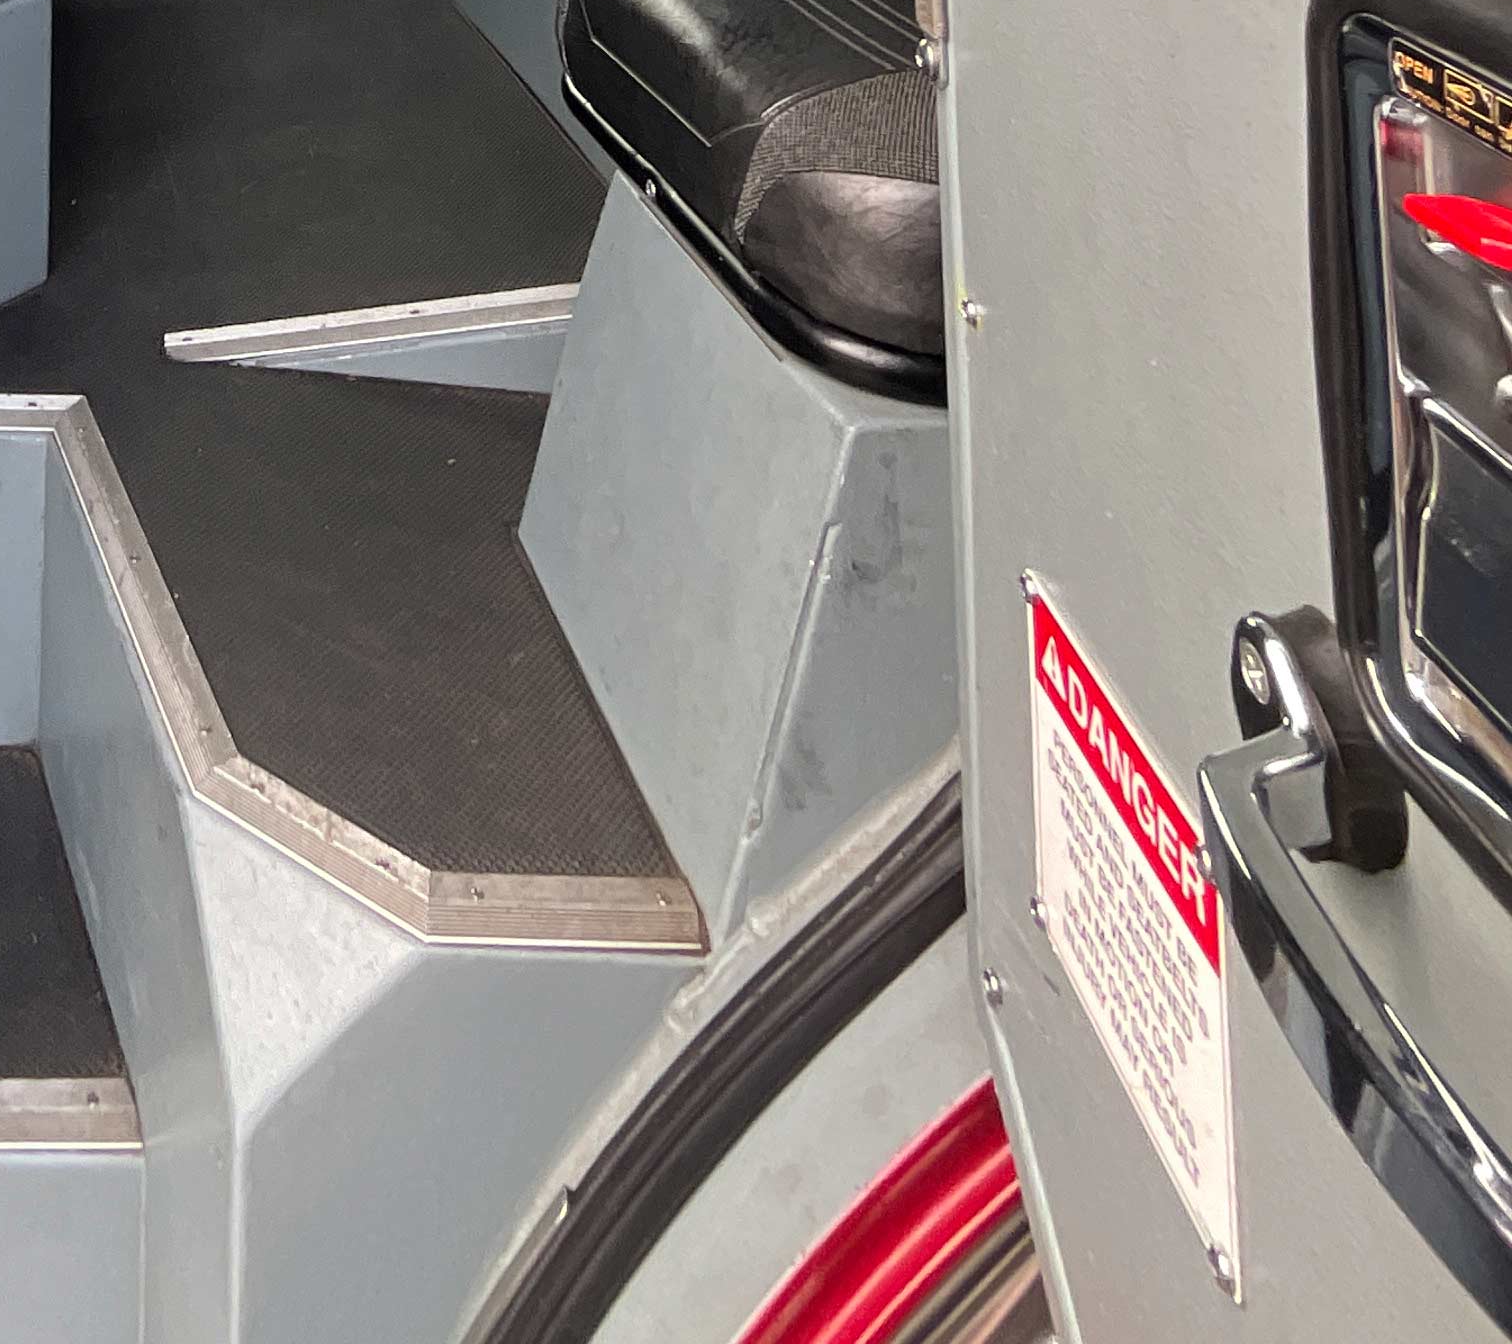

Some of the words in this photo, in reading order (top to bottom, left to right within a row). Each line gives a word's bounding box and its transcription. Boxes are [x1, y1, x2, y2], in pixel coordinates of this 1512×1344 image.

[1392, 50, 1433, 84] OPEN
[1047, 744, 1092, 840] SEATED
[1096, 827, 1122, 892] AND
[1053, 726, 1126, 869] PERSONNEL
[1132, 858, 1171, 945] MUST
[1176, 932, 1197, 990] BE
[1067, 672, 1206, 928] DANGER
[1060, 795, 1093, 871] MUST
[1098, 861, 1115, 911] BE
[1118, 897, 1192, 1047] FASTENED
[1065, 889, 1104, 981] DEATH
[1107, 968, 1127, 1024] OR
[1067, 836, 1105, 923] WHILE
[1109, 912, 1167, 1036] VEHICLE
[1078, 886, 1090, 925] IN
[1094, 915, 1148, 1030] MOTION
[1151, 1020, 1173, 1079] OR
[1109, 1003, 1138, 1077] MAY
[1142, 1064, 1199, 1193] RESULT
